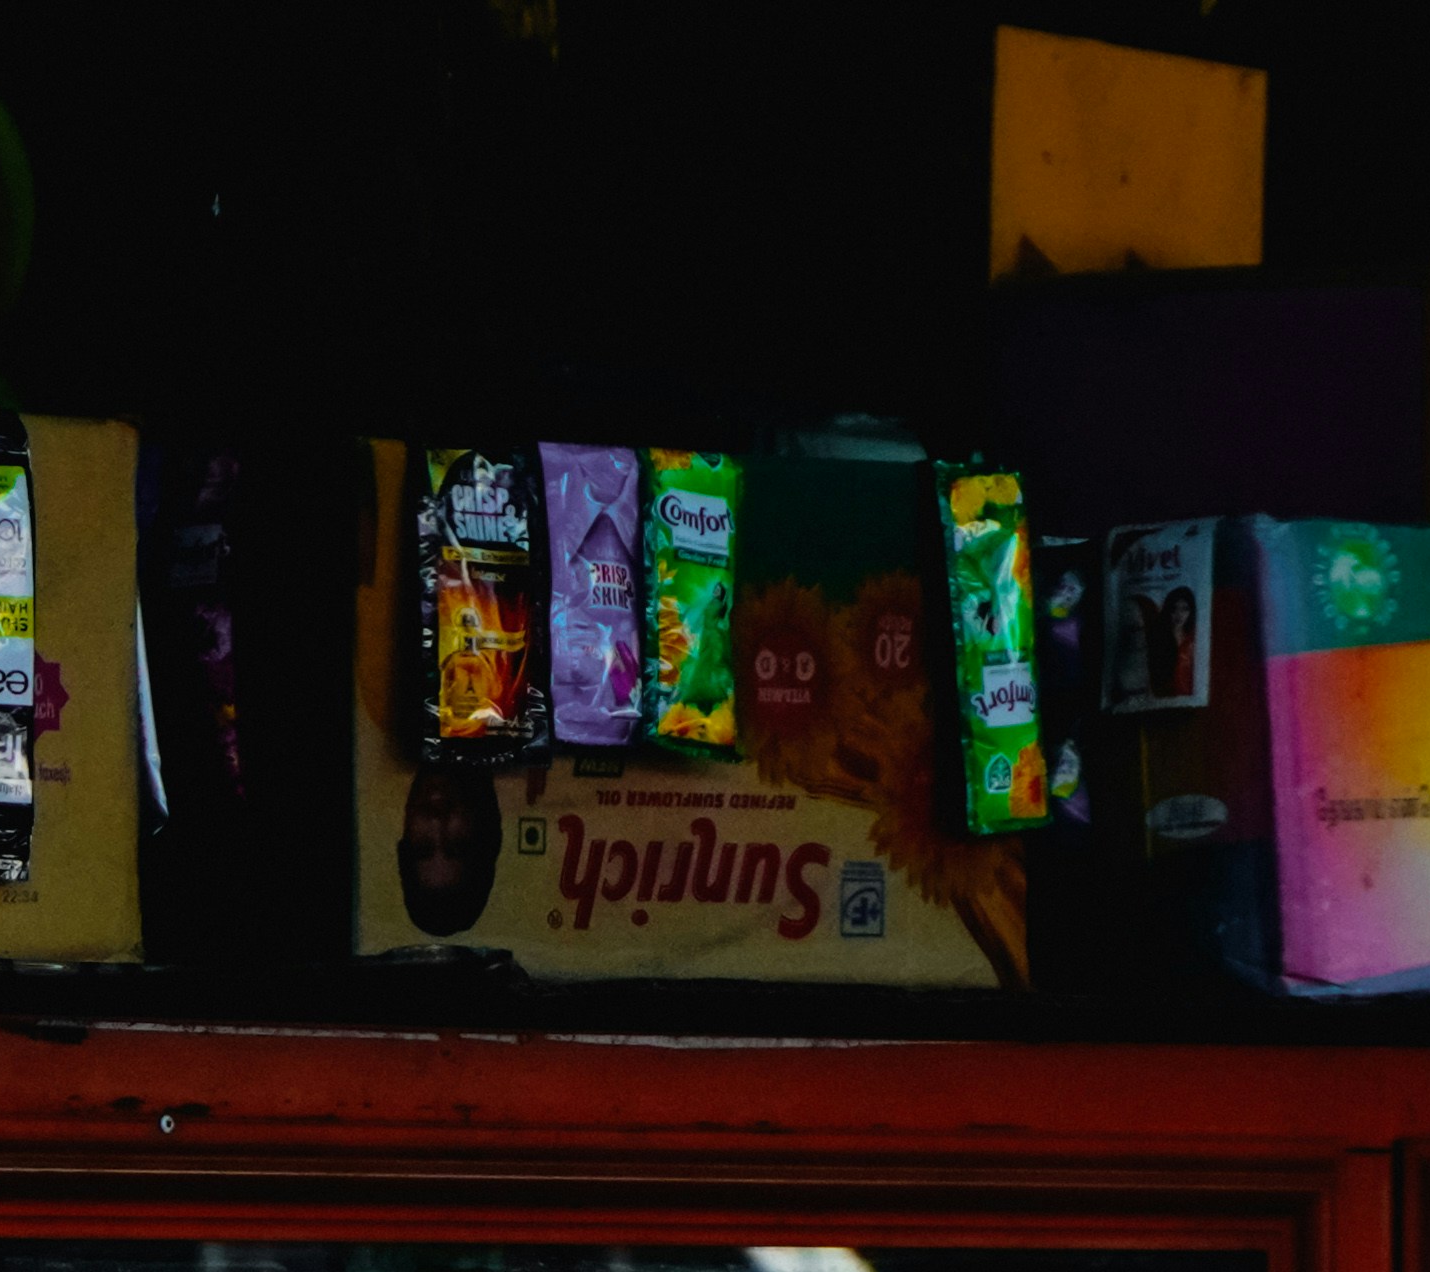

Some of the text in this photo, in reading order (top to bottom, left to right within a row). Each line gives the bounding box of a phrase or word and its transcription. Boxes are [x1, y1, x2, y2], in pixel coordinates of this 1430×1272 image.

[450, 483, 510, 516] CRISP
[659, 494, 735, 536] Comfort
[453, 512, 509, 542] SHINE
[592, 563, 628, 585] CRISP
[591, 587, 631, 611] SHINE
[874, 633, 913, 669] 20
[594, 788, 798, 811] REFINED SUNFLOWER OIL
[557, 813, 831, 941] Sunrich
